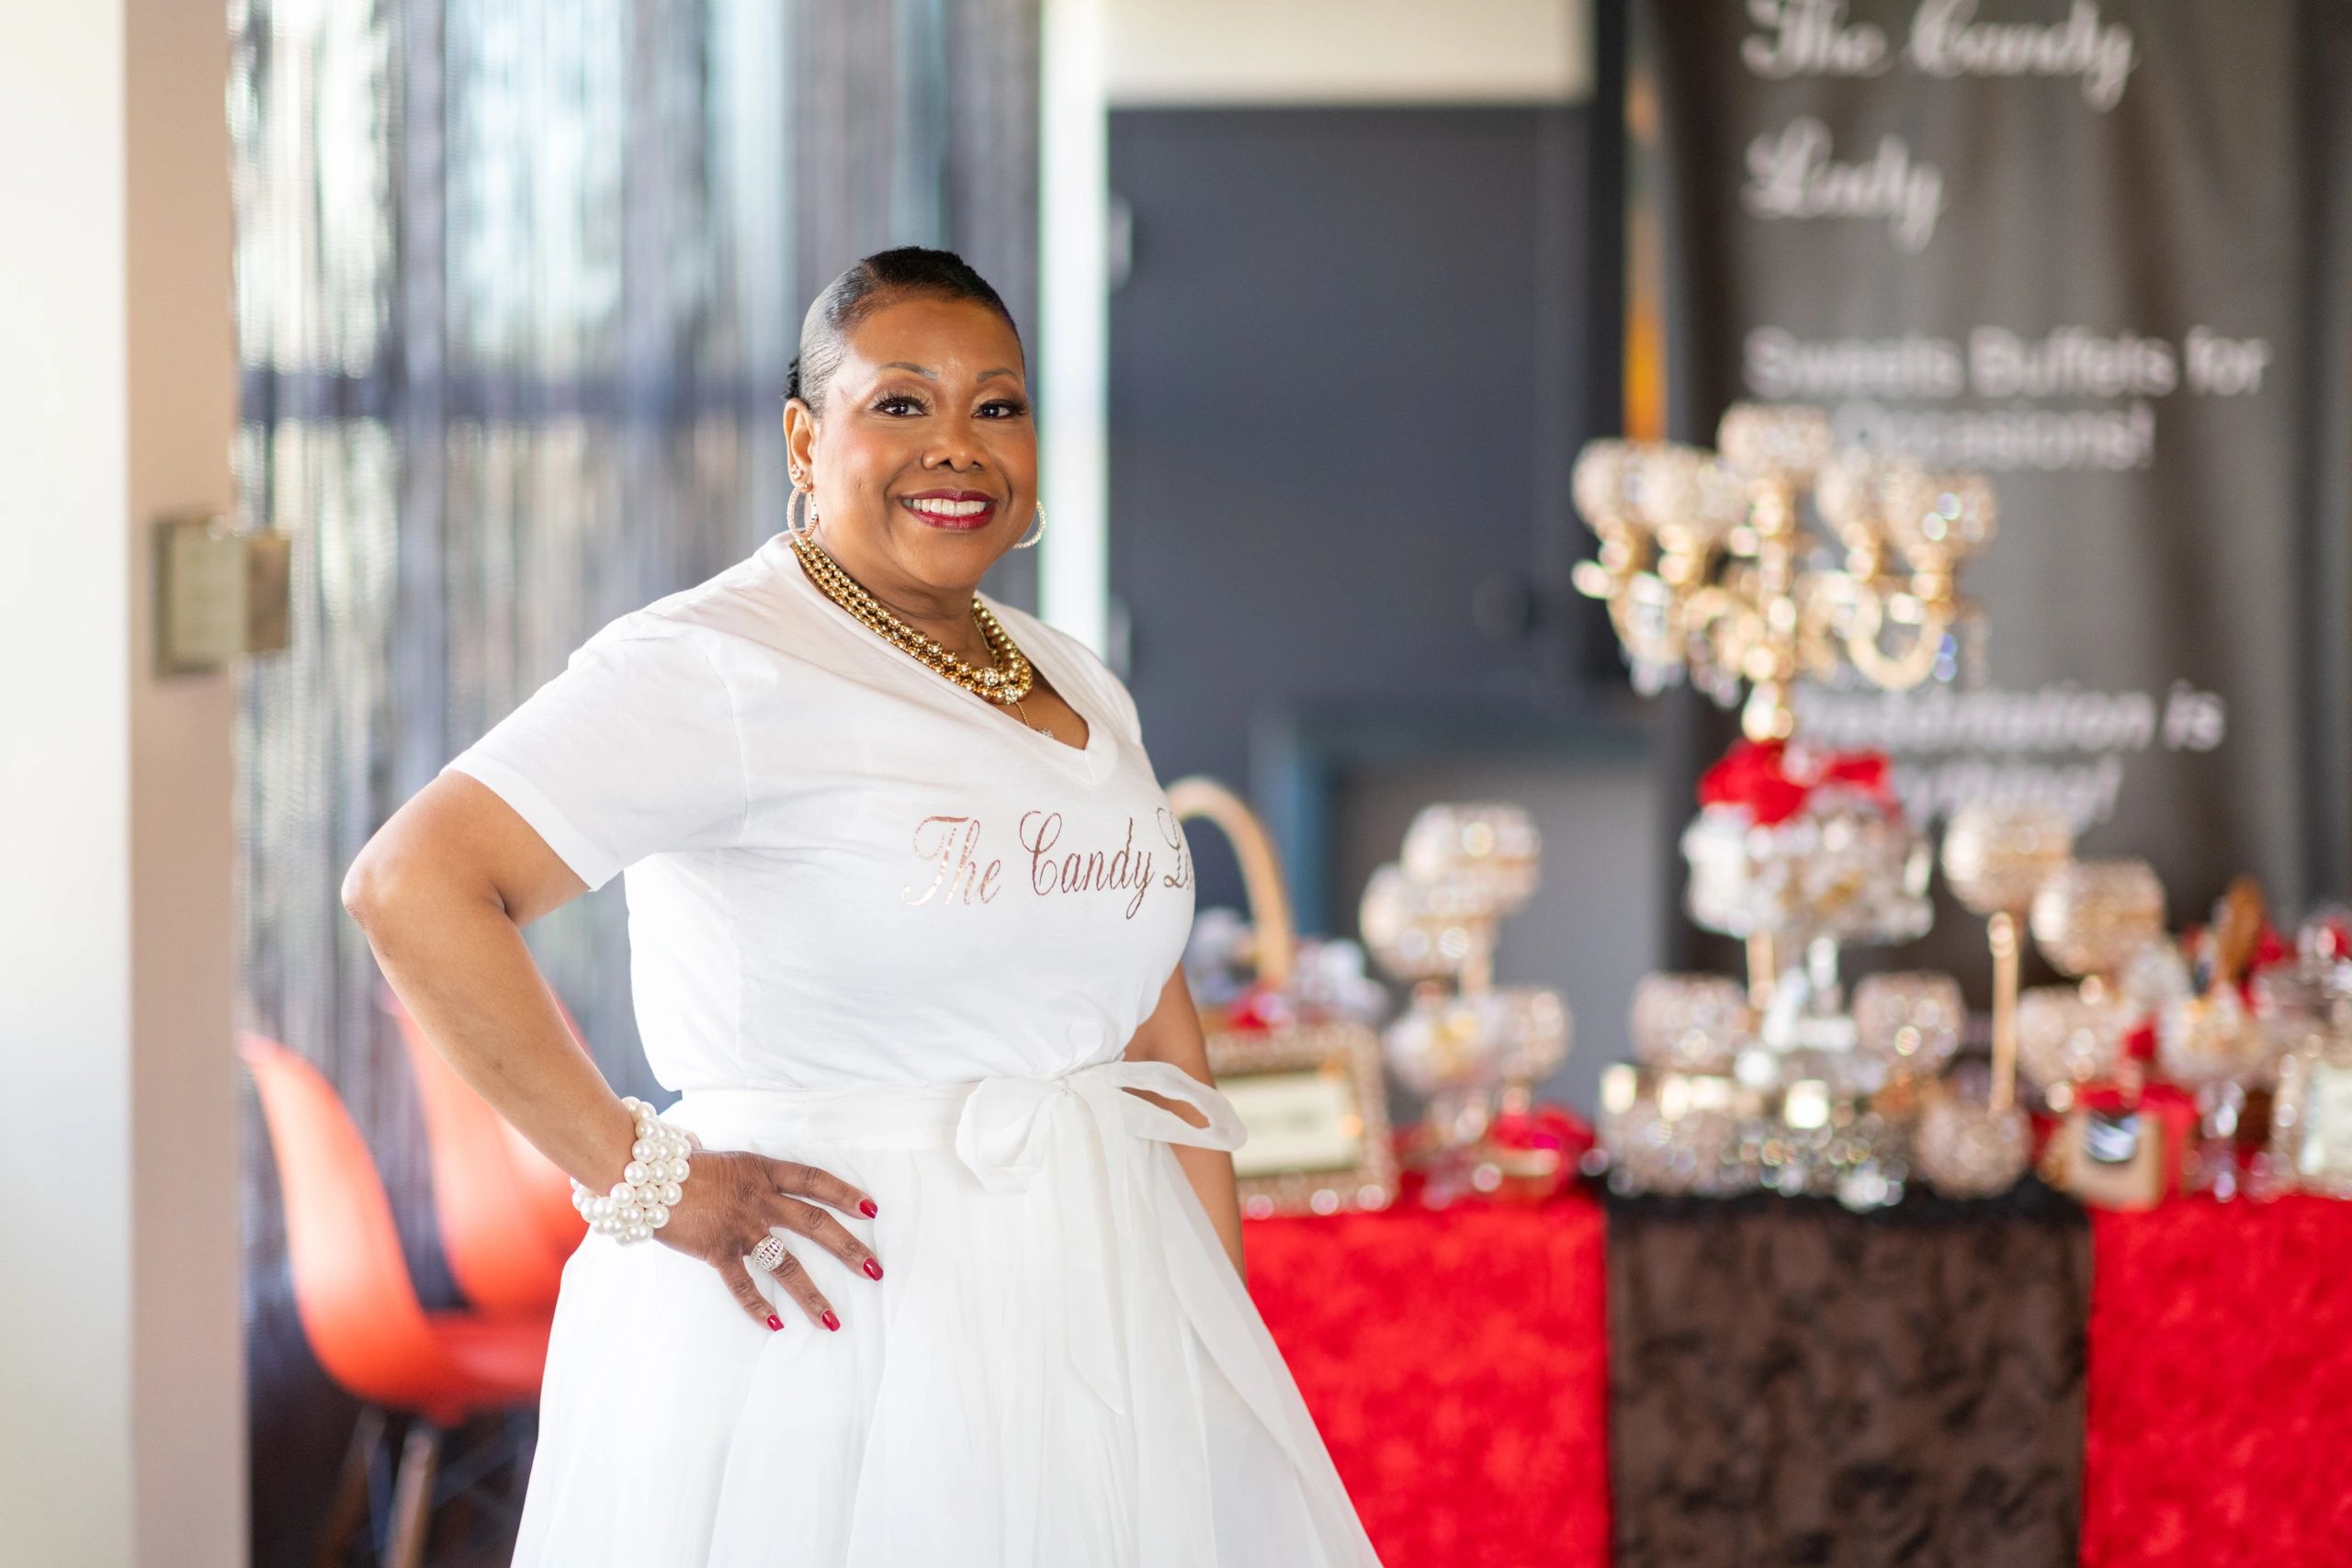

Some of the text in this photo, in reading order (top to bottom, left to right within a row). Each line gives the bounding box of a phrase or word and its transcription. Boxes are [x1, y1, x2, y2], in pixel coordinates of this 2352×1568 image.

[1740, 0, 2134, 111] The Candy
[1741, 117, 1944, 254] Lady
[1744, 325, 2270, 396] Sweets Buffets for
[900, 816, 1001, 907] The
[1019, 809, 1155, 920] Candy
